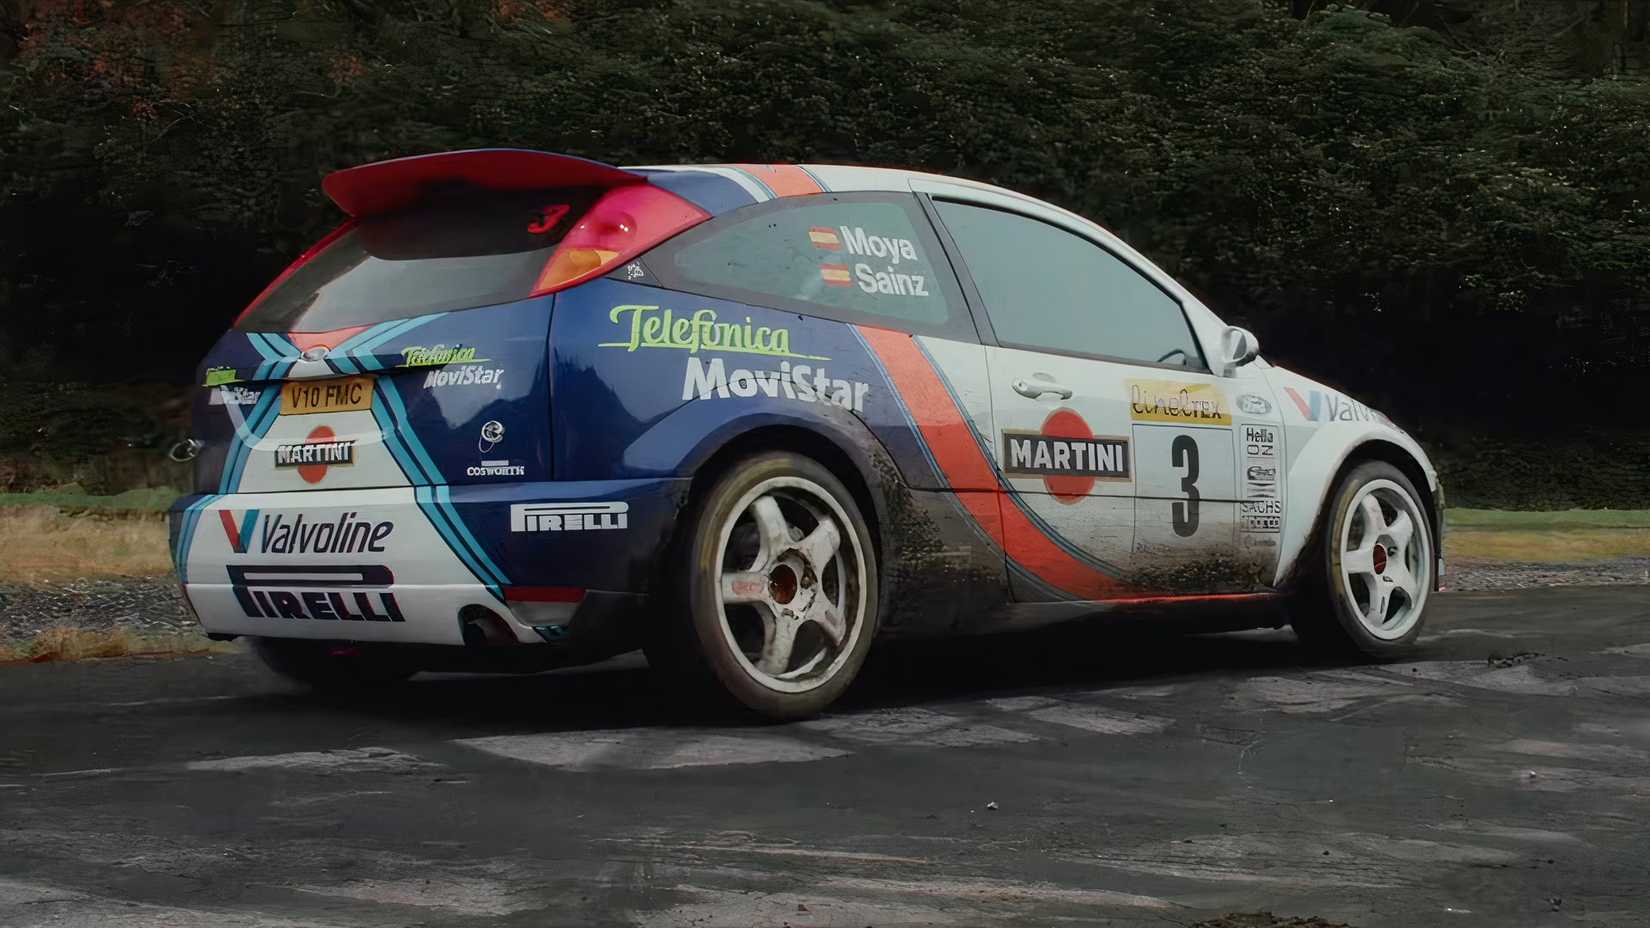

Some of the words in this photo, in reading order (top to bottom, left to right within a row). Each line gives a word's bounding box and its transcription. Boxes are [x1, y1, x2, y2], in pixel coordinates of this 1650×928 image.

[840, 226, 918, 264] Moya
[855, 263, 929, 296] Sainz
[423, 365, 504, 389] MoviStar
[682, 356, 869, 412] MoviStar
[292, 387, 320, 409] V10
[325, 383, 362, 407] FMC
[1246, 428, 1273, 442] Hella
[277, 442, 352, 464] MARTINI
[1009, 438, 1124, 473] MARTINI
[1171, 434, 1200, 538] 3
[262, 510, 395, 555] Valvoline
[510, 501, 630, 532] PIRELLI
[225, 564, 406, 623] PIRELLI
